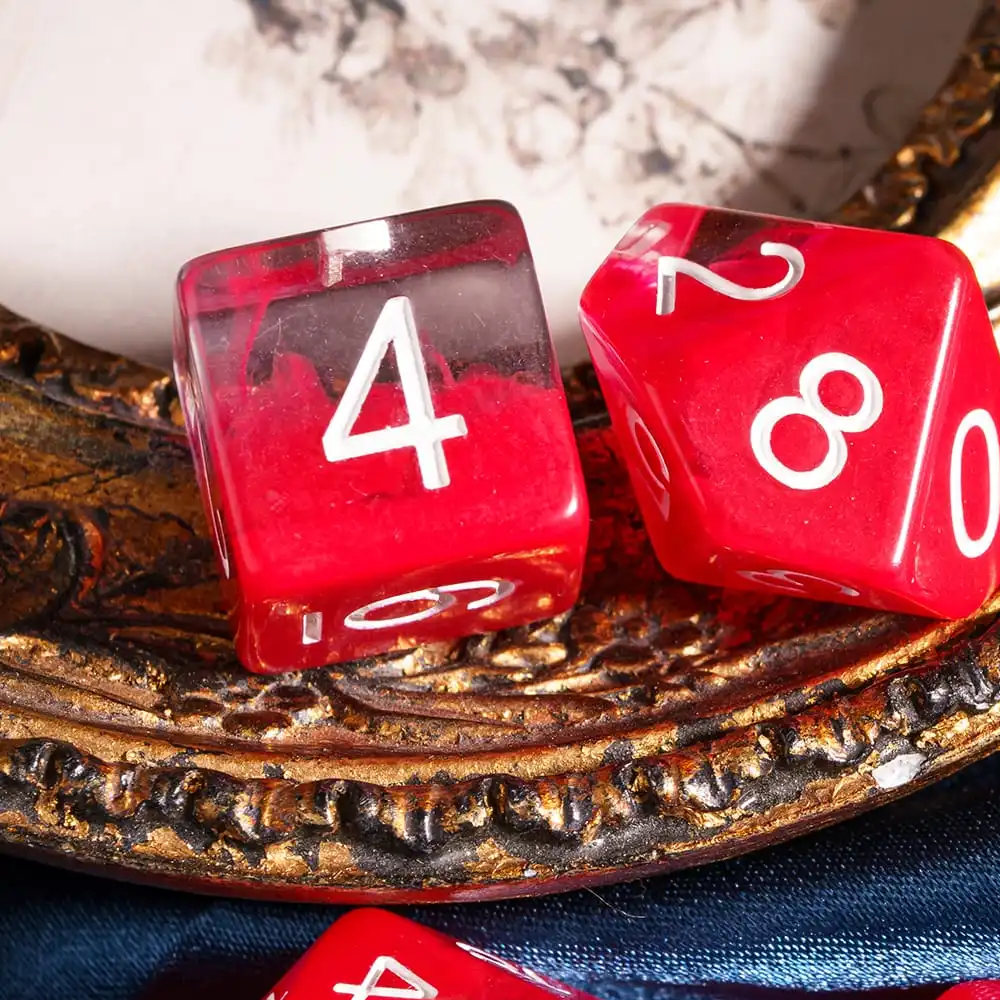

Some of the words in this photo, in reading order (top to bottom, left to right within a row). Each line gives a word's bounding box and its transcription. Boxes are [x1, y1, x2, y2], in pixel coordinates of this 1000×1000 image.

[656, 241, 805, 315] 2
[322, 296, 468, 490] 4
[751, 352, 883, 490] 8
[950, 408, 1000, 559] 0
